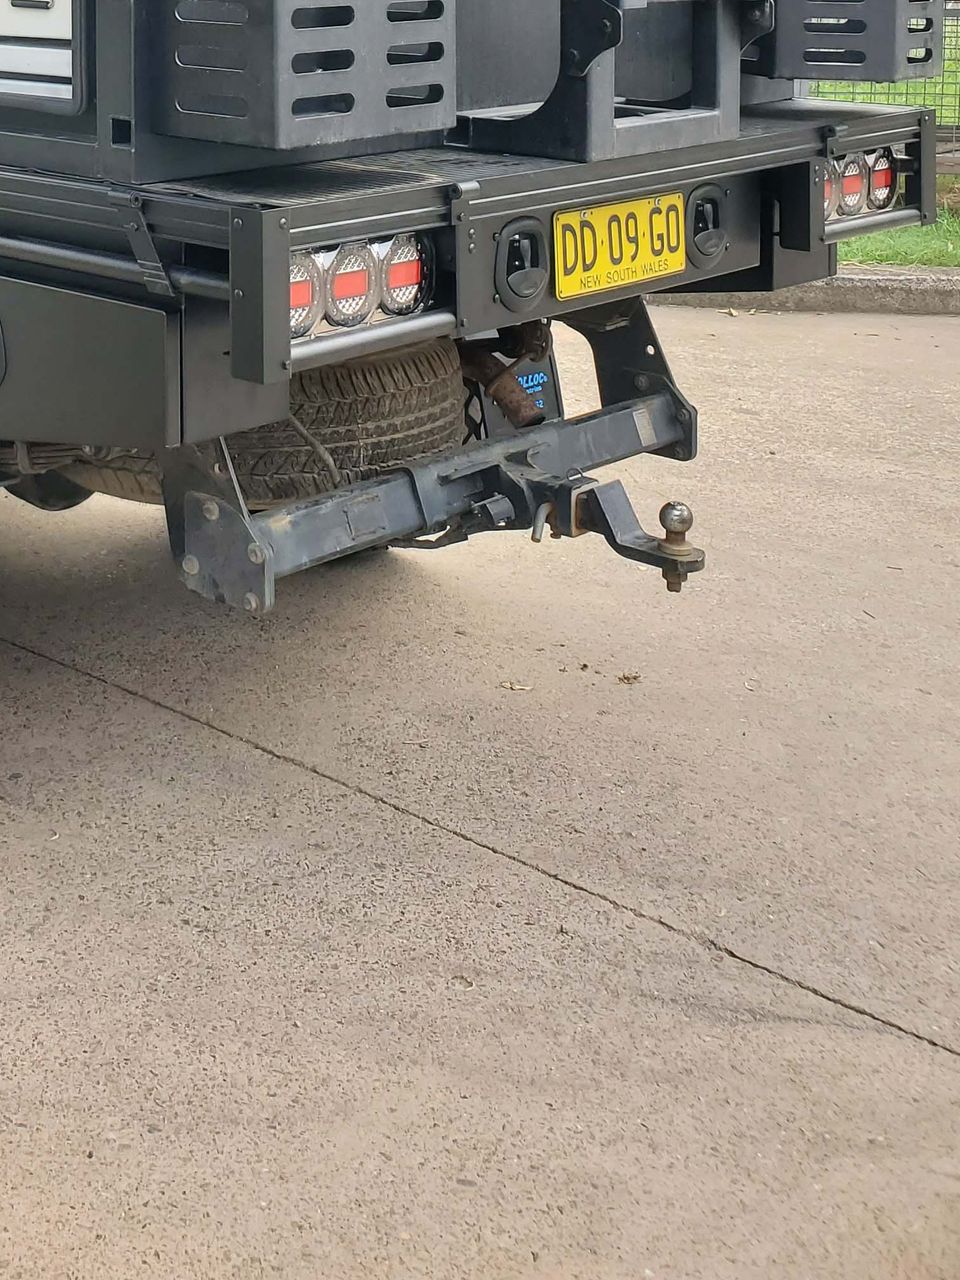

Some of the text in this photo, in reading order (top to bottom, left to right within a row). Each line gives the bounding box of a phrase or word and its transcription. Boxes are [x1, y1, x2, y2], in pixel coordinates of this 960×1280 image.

[580, 258, 669, 289] NEW SOUTH WALES
[517, 372, 544, 388] OLLOC
